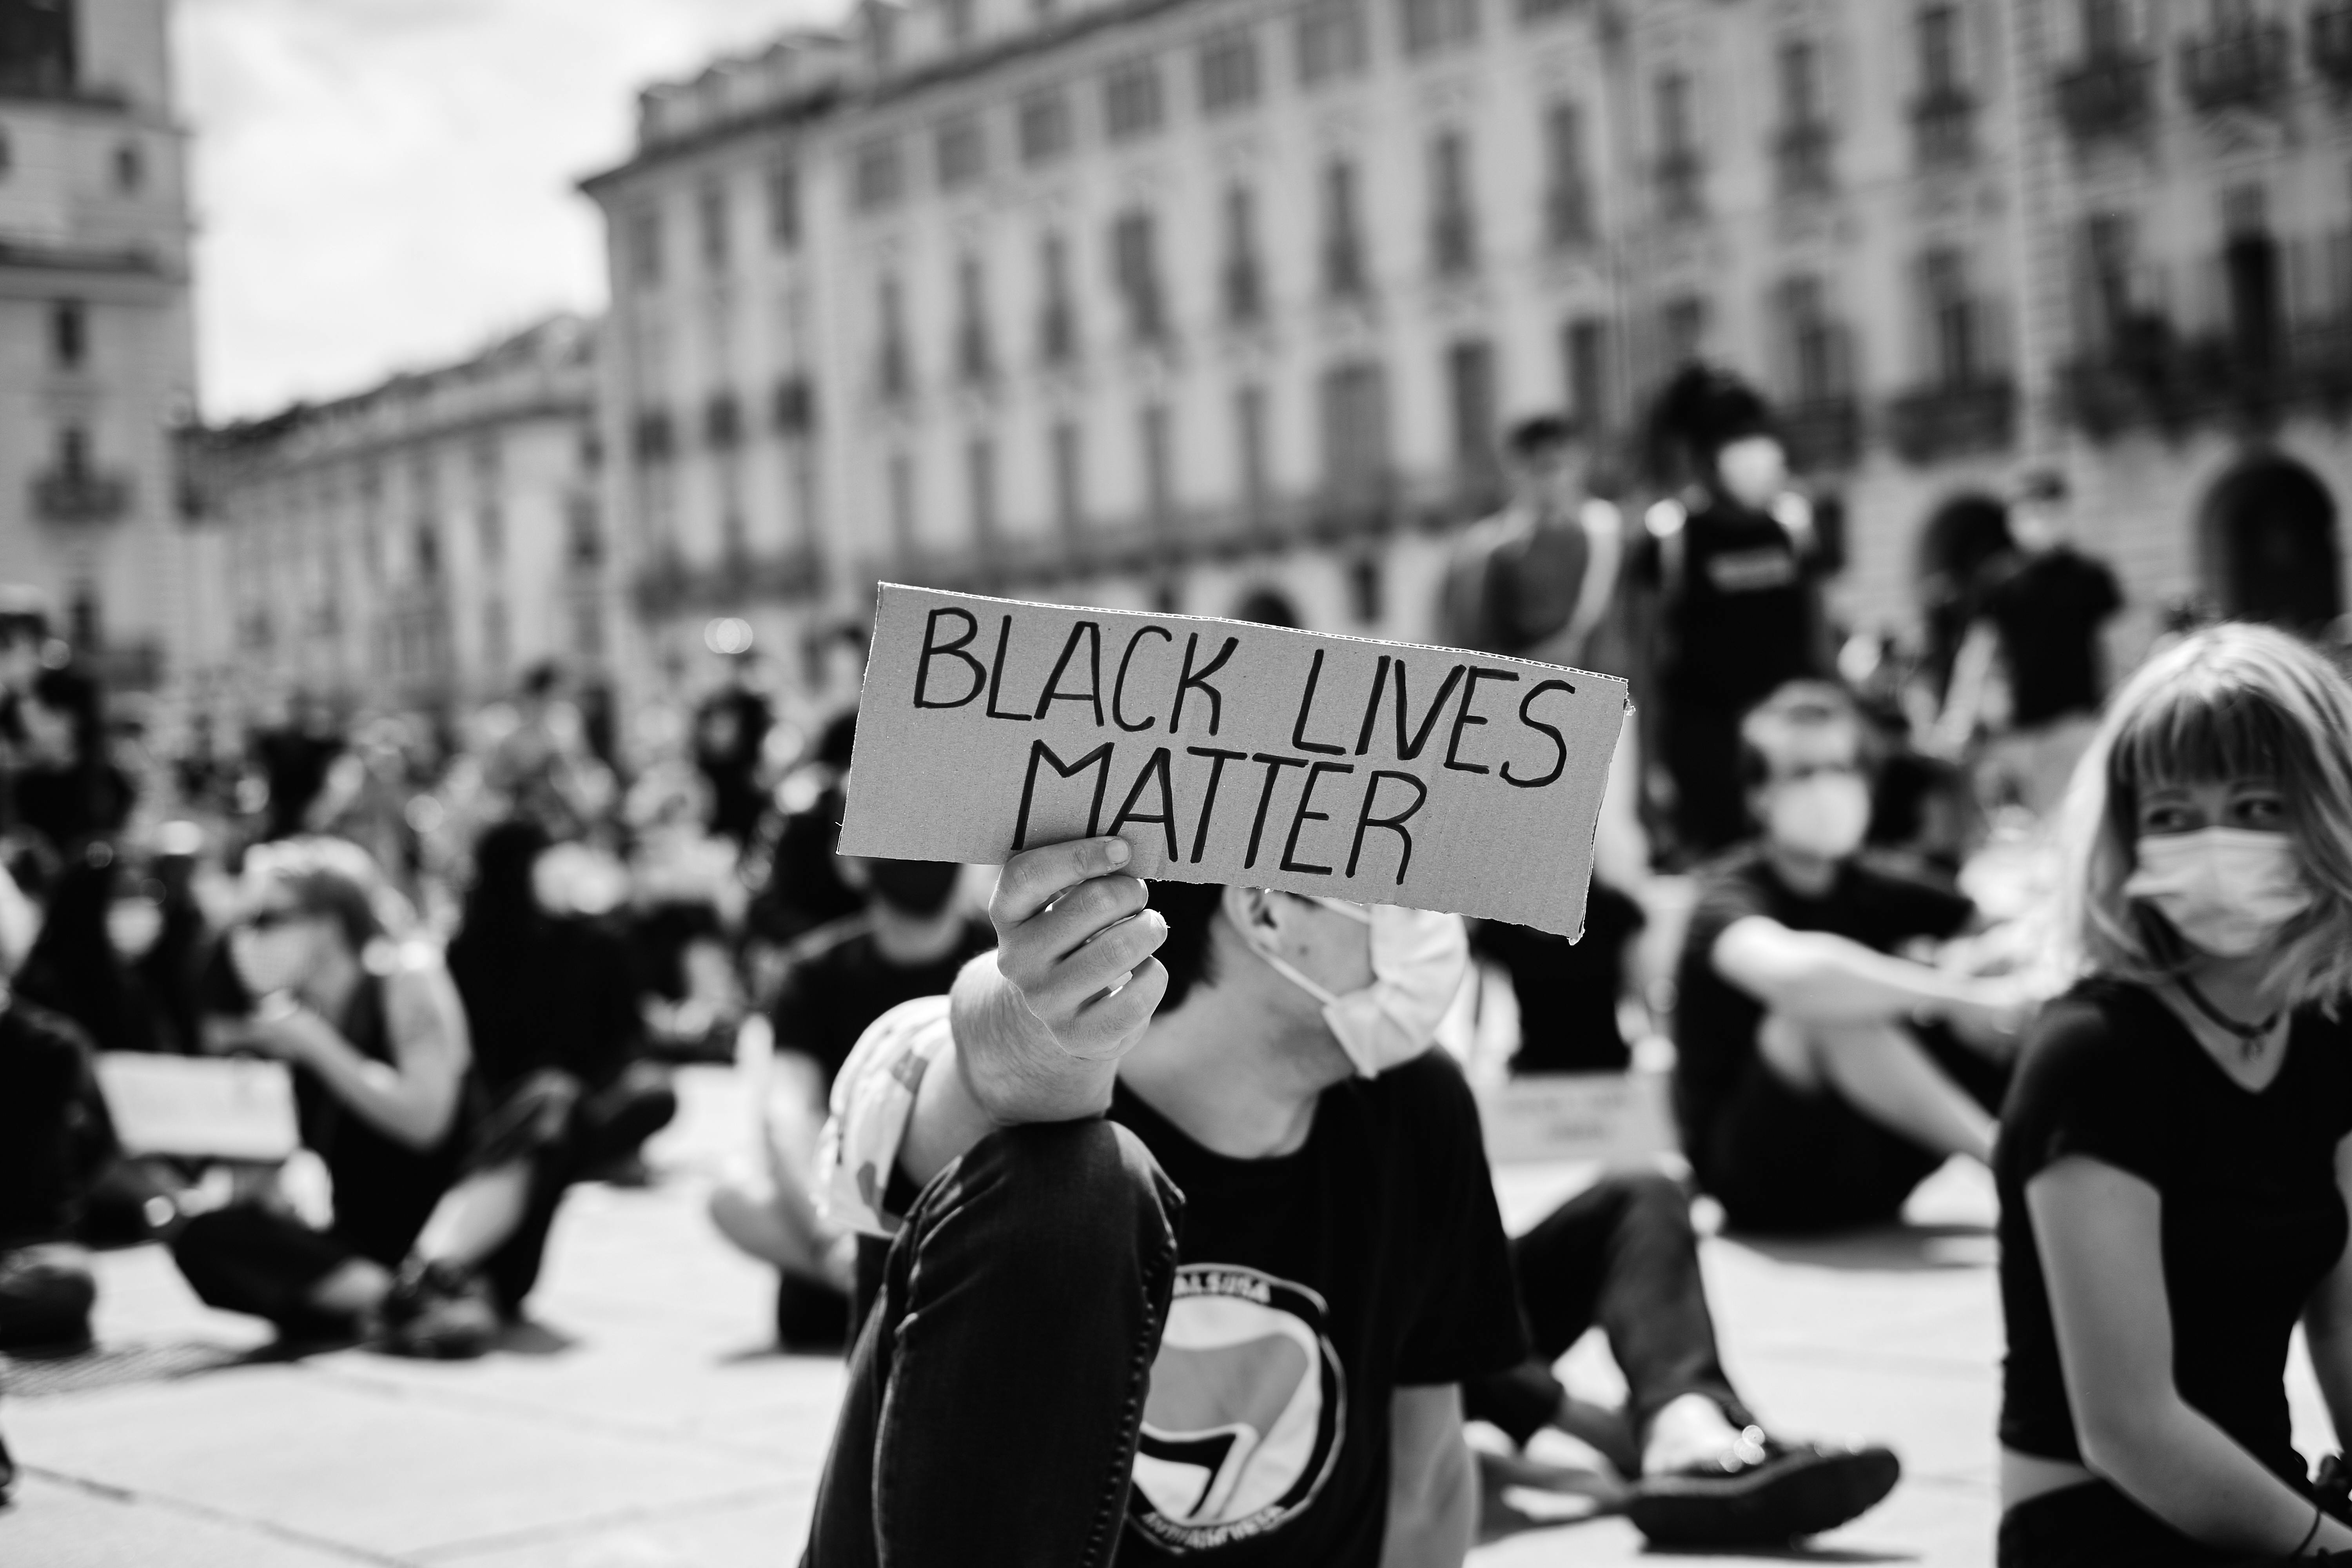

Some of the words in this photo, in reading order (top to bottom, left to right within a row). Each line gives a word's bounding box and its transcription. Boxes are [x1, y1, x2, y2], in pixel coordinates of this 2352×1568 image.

[913, 607, 1240, 736] BLACK
[1292, 648, 1576, 788] LIVES
[1010, 739, 1428, 886] MATTER
